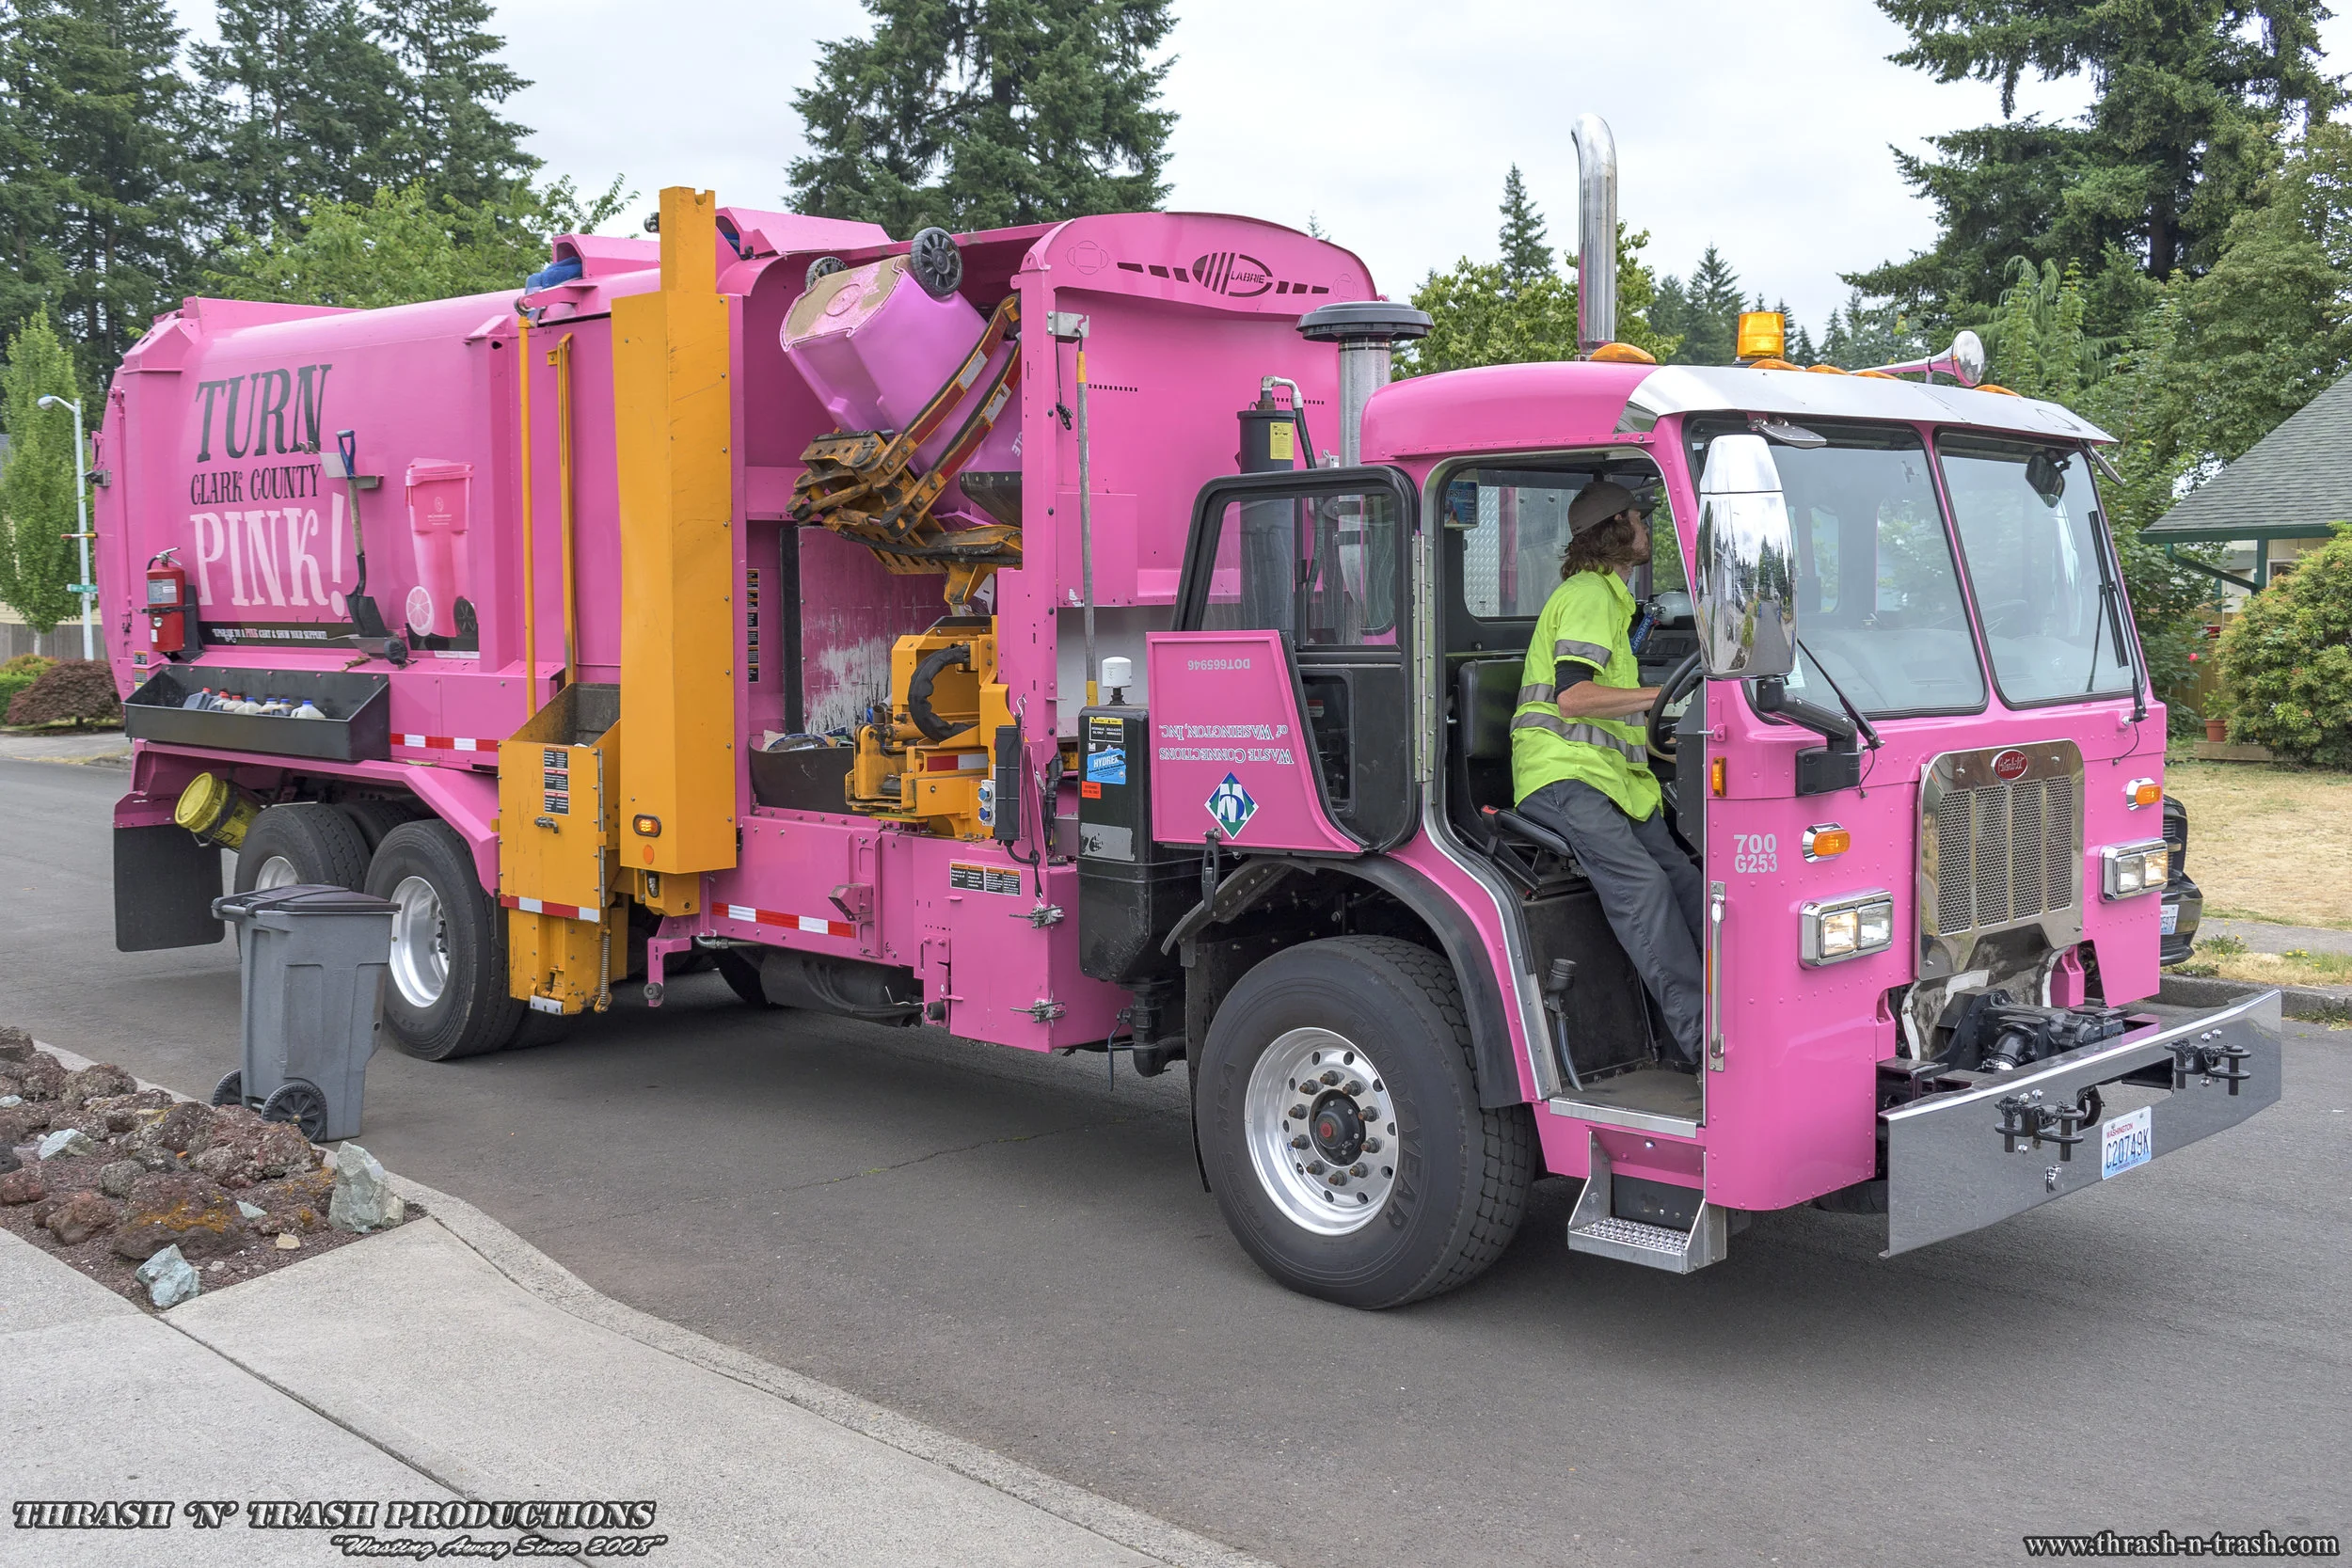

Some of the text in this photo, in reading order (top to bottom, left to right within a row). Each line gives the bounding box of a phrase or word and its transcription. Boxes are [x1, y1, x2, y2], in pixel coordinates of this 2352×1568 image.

[1231, 271, 1265, 283] LABRIE
[195, 364, 332, 463] TURN
[191, 464, 321, 505] CLARK COUNTY
[189, 492, 345, 617] PINK!
[1187, 658, 1250, 671] DOT665946
[1159, 748, 1295, 764] WASTE CONNECTIONS
[1734, 833, 1777, 853] 700
[1735, 853, 1777, 873] G253
[2106, 1122, 2134, 1139] WASHINGTON
[2106, 1128, 2149, 1168] C20749K
